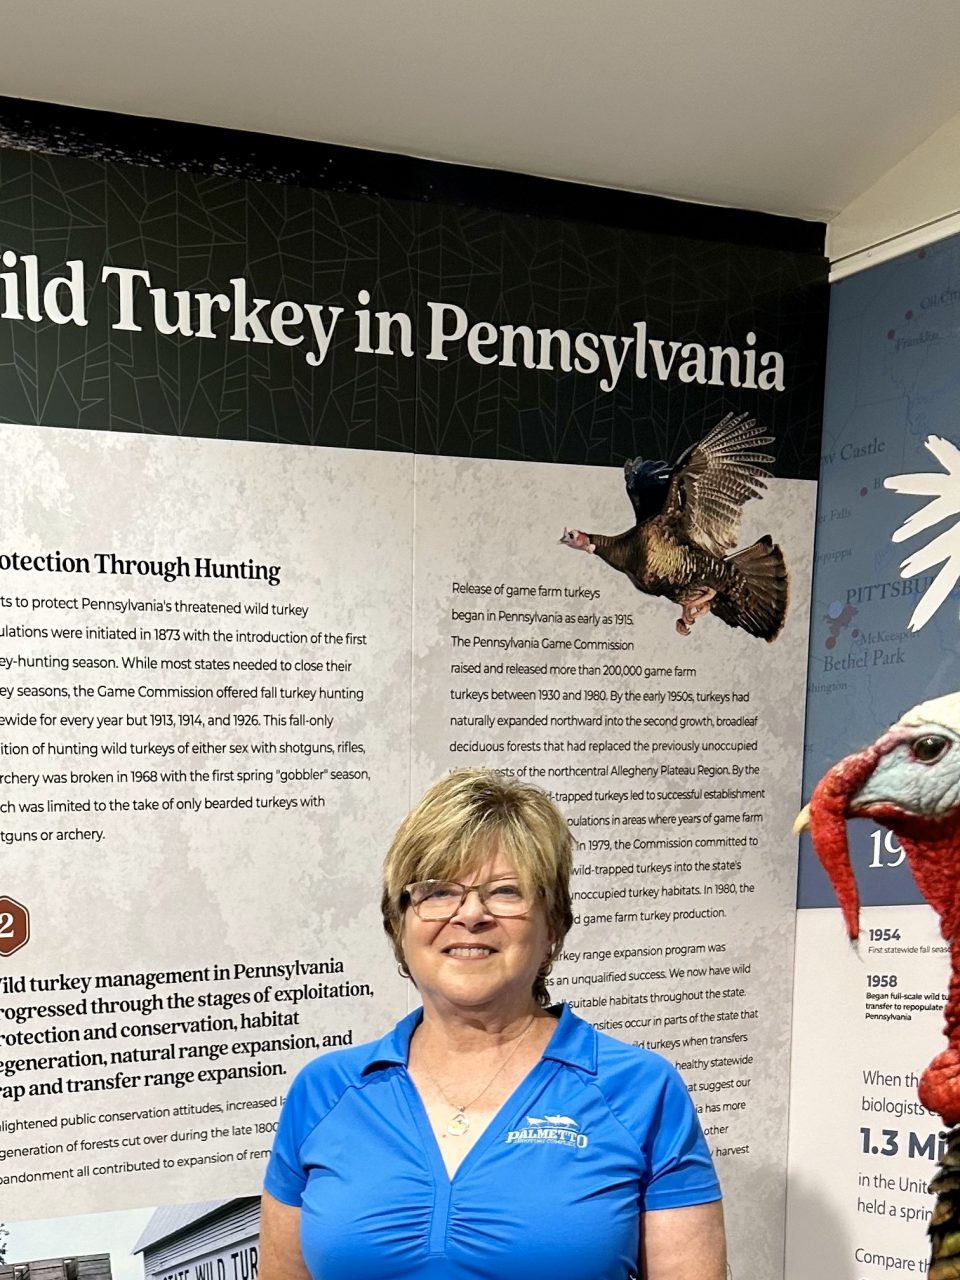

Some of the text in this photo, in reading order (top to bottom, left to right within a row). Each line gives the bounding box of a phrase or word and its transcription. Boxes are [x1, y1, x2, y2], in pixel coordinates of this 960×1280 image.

[101, 266, 344, 366] Turkey
[354, 290, 414, 357] in
[426, 302, 785, 392] Pennsylvania
[840, 437, 886, 461] Castle
[94, 553, 190, 583] Through
[194, 558, 281, 586] Hunting
[15, 597, 29, 608] to
[32, 598, 79, 611] protect
[82, 597, 172, 614] Pennsylvania's
[174, 600, 241, 614] threatened
[244, 602, 269, 615] wild
[271, 603, 309, 619] turkey
[451, 635, 634, 651] The Pennsylvania Game Commission
[824, 648, 905, 672] Bethel Park
[868, 928, 901, 942] 1954
[868, 946, 883, 954] First
[884, 945, 919, 954] statewide
[920, 945, 931, 954] fall
[29, 974, 92, 994] turkey
[95, 968, 210, 990] management
[213, 964, 231, 981] in
[233, 957, 344, 981] Pennsylvania
[866, 974, 898, 988] 1958
[90, 994, 164, 1016] through
[166, 993, 194, 1009] the
[198, 992, 251, 1010] stages
[253, 986, 272, 1003] of
[274, 981, 374, 1005] exploitation,
[865, 992, 889, 1001] Began
[890, 992, 922, 1000] full-scale
[924, 992, 940, 1001] wild
[865, 1002, 893, 1010] transfer
[903, 1003, 944, 1012] repopulate
[83, 1022, 117, 1040] and
[120, 1015, 238, 1038] conservation,
[240, 1010, 300, 1029] habitat
[865, 1012, 912, 1022] Pennsylvania
[110, 1043, 175, 1064] natural
[178, 1044, 228, 1061] range
[231, 1031, 320, 1057] expansion,
[322, 1030, 353, 1047] and
[29, 1077, 63, 1096] and
[66, 1070, 141, 1093] transfer
[144, 1071, 194, 1088] range
[197, 1061, 287, 1085] expansion.
[862, 1070, 901, 1087] When
[862, 1095, 925, 1118] biologists
[505, 1129, 588, 1149] PALMETTO
[859, 1127, 899, 1156] 1.3
[858, 1171, 933, 1195] in the Unit
[857, 1196, 933, 1222] held a sprin
[854, 1247, 916, 1271] Compare
